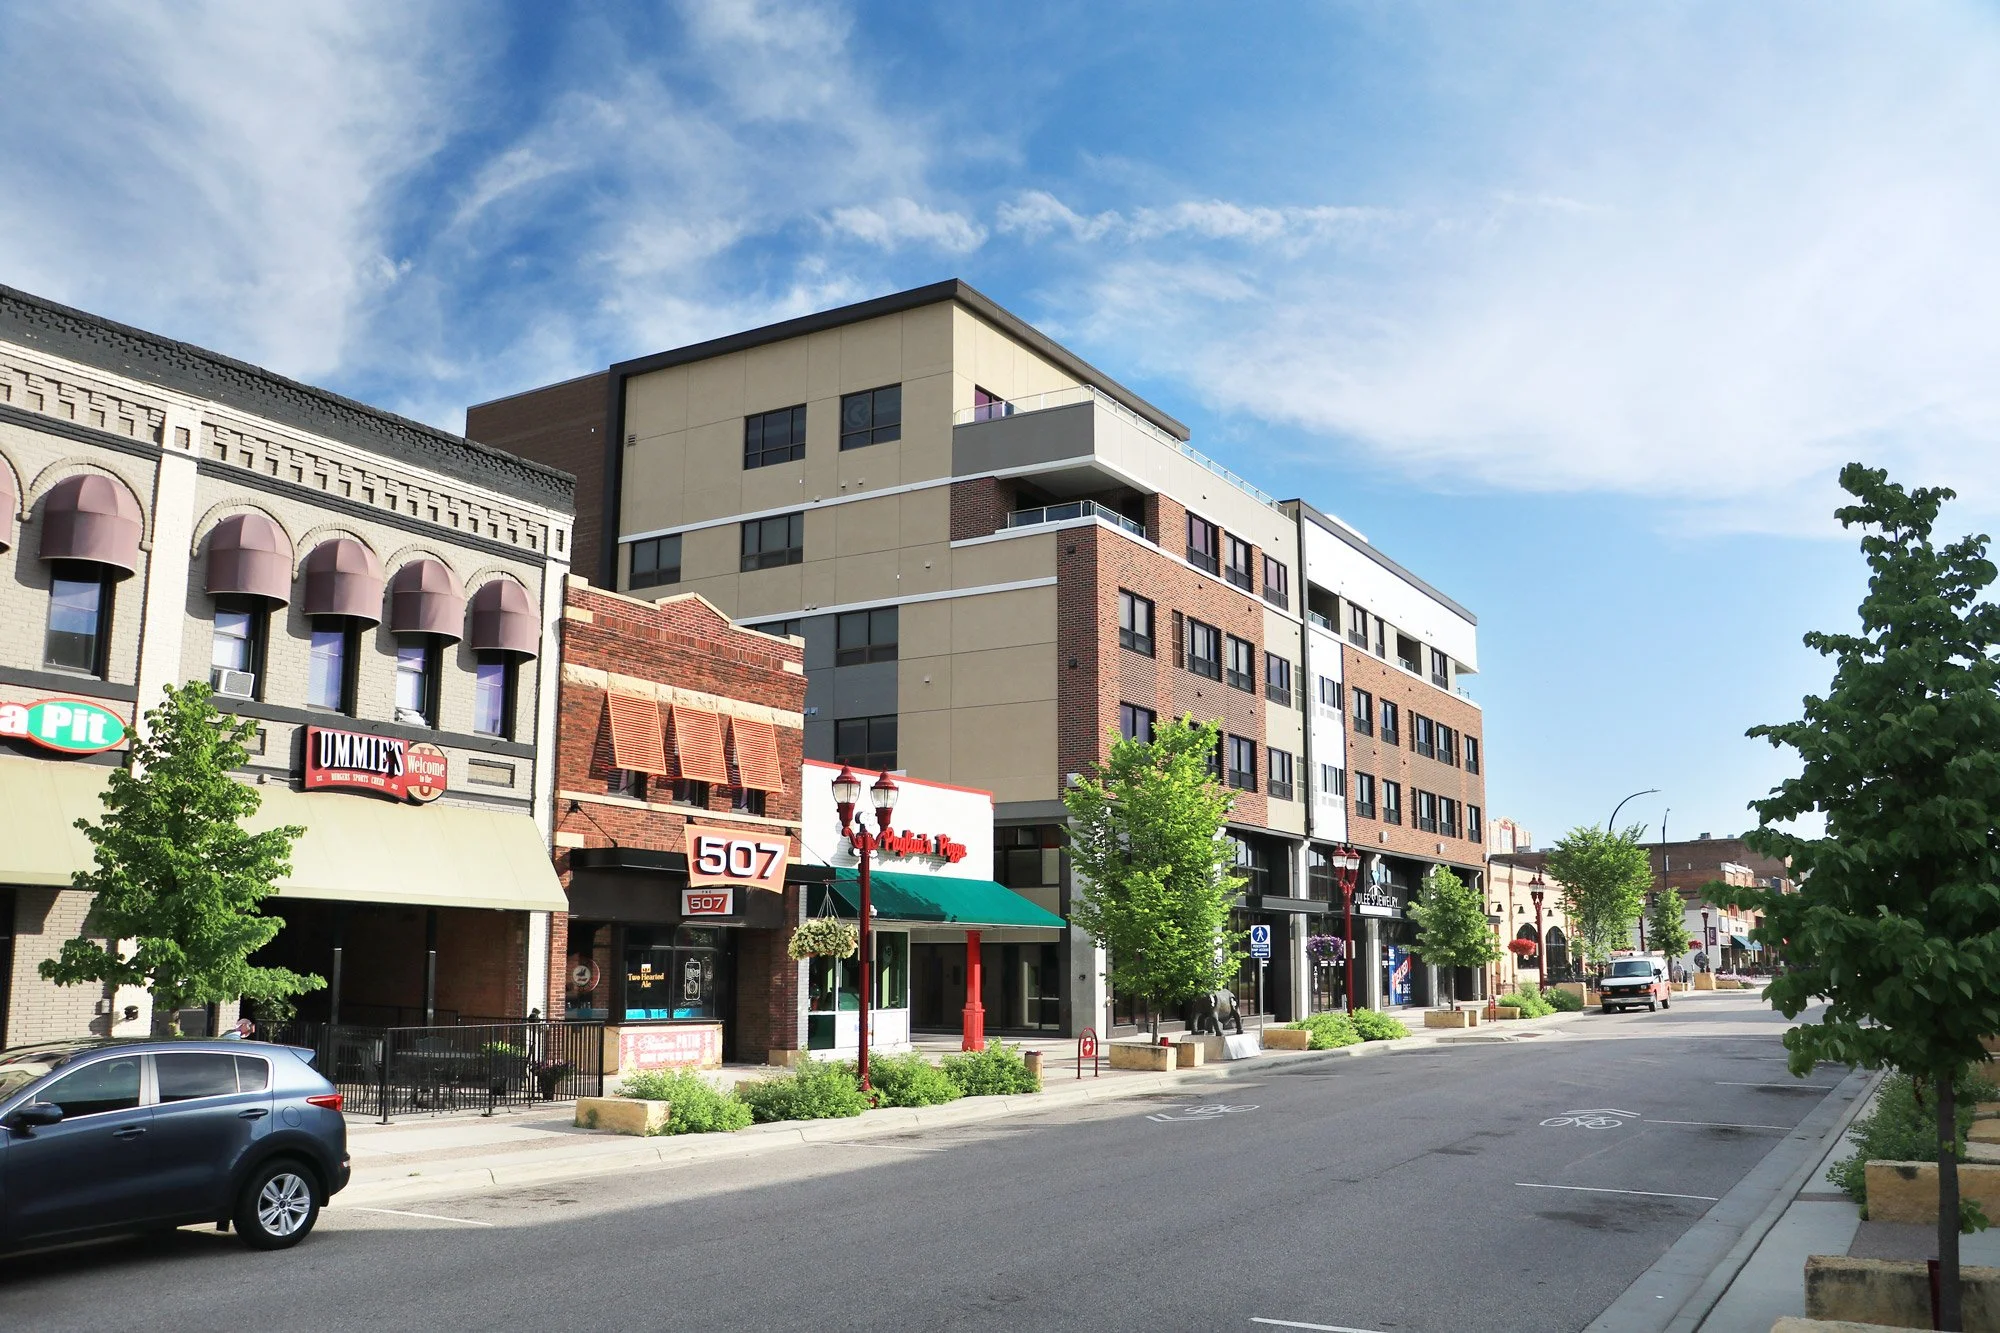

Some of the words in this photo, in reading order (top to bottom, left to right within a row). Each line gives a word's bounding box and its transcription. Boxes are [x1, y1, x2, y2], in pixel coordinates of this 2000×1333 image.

[41, 704, 109, 744] Pit
[319, 731, 404, 777] UMMIE'S
[407, 755, 445, 777] Welcome
[331, 772, 350, 781] BURGERS
[352, 774, 369, 783] SPORTS
[419, 775, 424, 783] to
[695, 836, 785, 879] 507
[938, 833, 967, 863] Pizza
[691, 897, 724, 910] 507
[1354, 892, 1375, 906] JULEE'S
[1376, 894, 1399, 908] JEWELRY
[627, 973, 641, 981] Two
[641, 972, 665, 981] Hearted
